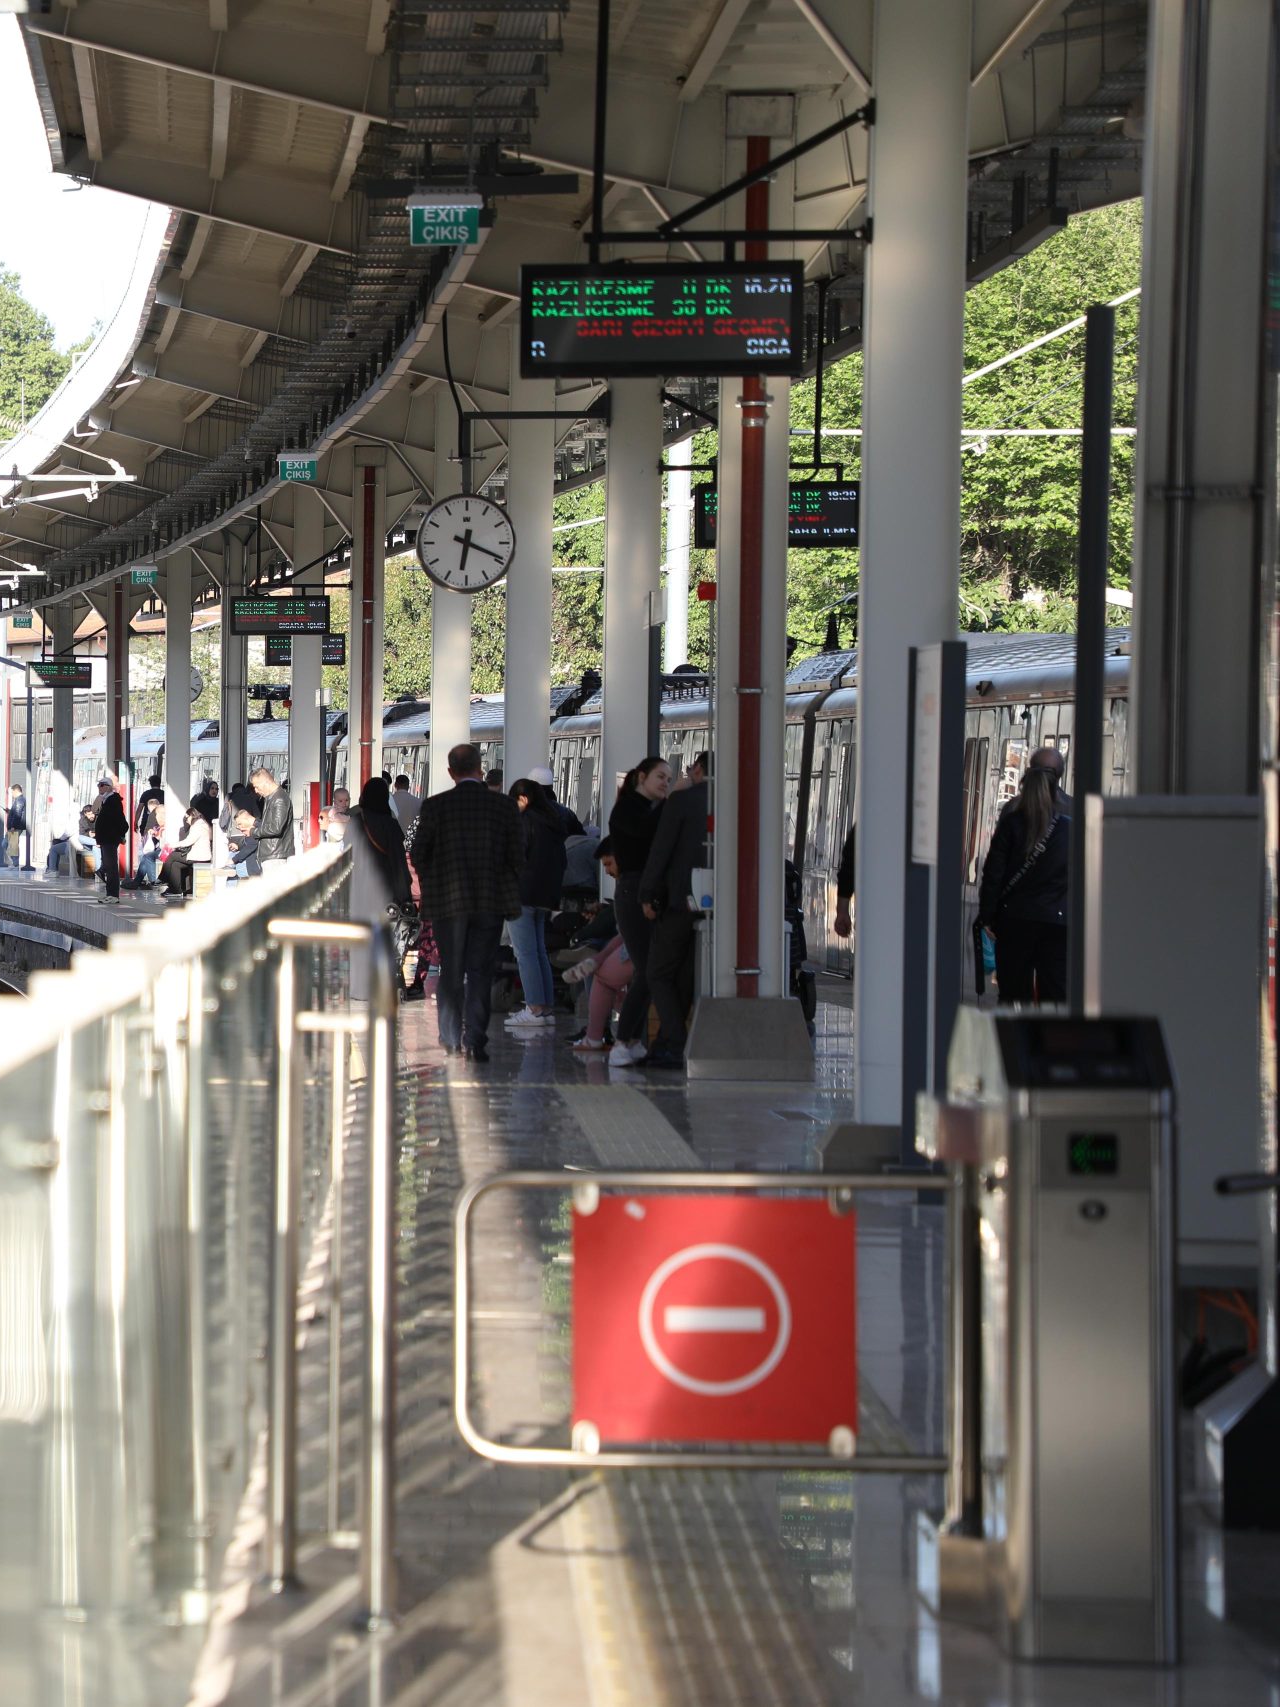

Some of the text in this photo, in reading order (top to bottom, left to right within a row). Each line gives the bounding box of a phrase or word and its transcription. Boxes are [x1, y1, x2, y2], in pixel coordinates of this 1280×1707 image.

[423, 208, 467, 223] EXIT
[422, 225, 469, 243] ÇIKIŞ
[705, 279, 732, 294] DK
[705, 299, 733, 316] DK
[286, 461, 310, 470] EXIT
[285, 470, 312, 481] ÇIKIŞ
[806, 491, 822, 501] DK
